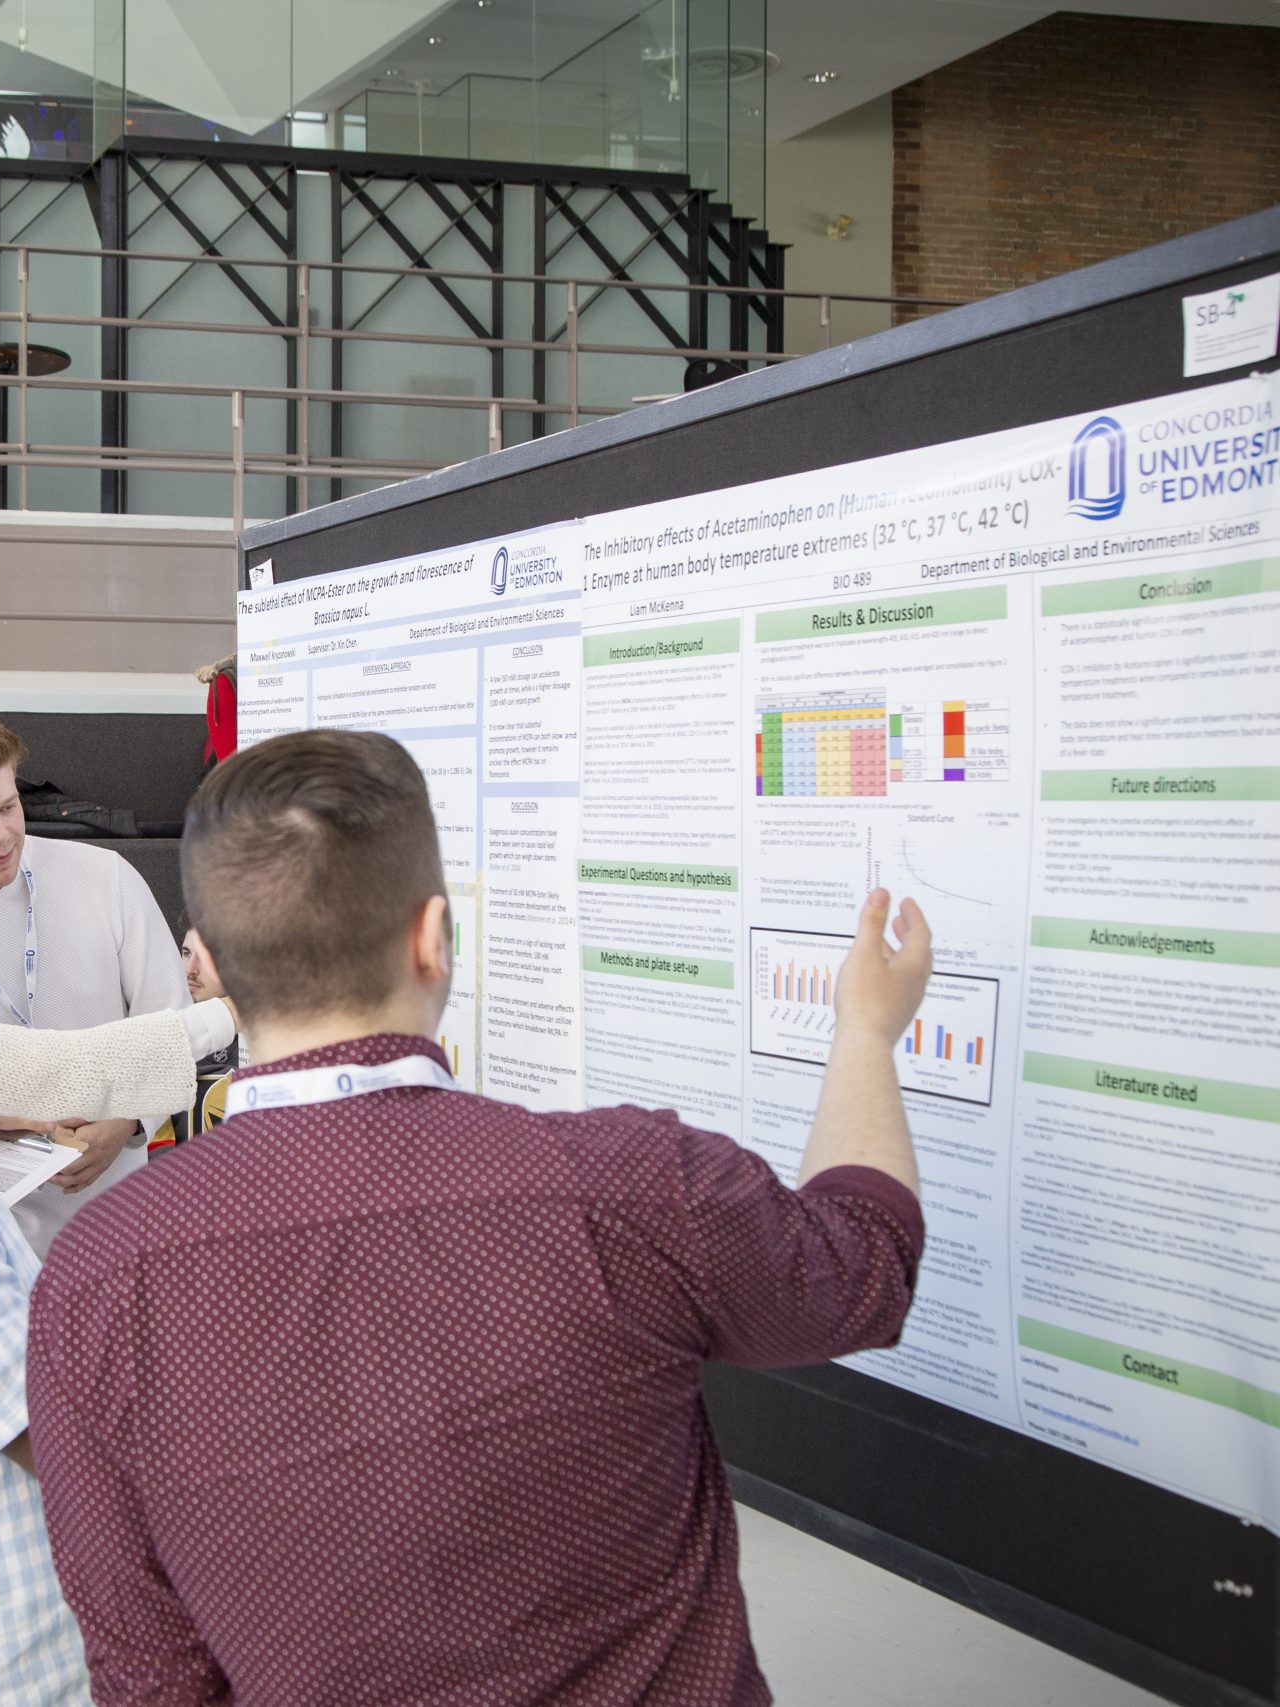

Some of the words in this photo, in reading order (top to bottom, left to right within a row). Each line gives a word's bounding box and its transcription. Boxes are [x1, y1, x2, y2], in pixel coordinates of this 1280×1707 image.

[1138, 401, 1273, 443] CONCORDIA
[1139, 482, 1159, 494] OF
[1161, 459, 1280, 503] EDMONT
[585, 544, 601, 561] The
[604, 535, 654, 557] Inhibitory
[657, 526, 694, 548] effects
[697, 520, 711, 541] of
[713, 504, 812, 537] Acetaminophen
[818, 501, 834, 519] on
[839, 493, 896, 520] (Human
[1018, 457, 1062, 484] COX-
[511, 546, 547, 560] CONCORDIA
[583, 576, 588, 591] 1
[592, 568, 629, 591] Enzyme
[633, 566, 643, 583] at
[646, 559, 684, 580] human
[688, 552, 716, 576] body
[720, 540, 799, 571] temperature
[803, 531, 868, 556] extremes
[873, 523, 895, 550] (32
[902, 519, 921, 543] °C,
[927, 515, 945, 538] 37
[952, 511, 973, 535] °C,
[979, 507, 998, 529] 42
[1005, 500, 1029, 529] °C)
[921, 558, 990, 580] Department
[993, 553, 1006, 569] of
[1009, 544, 1069, 567] Biological
[1074, 542, 1098, 559] and
[1104, 526, 1204, 556] Environmental
[1209, 520, 1260, 542] Sciences
[510, 557, 557, 576] UNIVERSITY
[238, 601, 253, 614] The
[254, 596, 279, 613] sublethal
[281, 592, 296, 608] effect
[298, 589, 305, 603] of
[306, 583, 345, 601] MCPA-Ester
[347, 584, 356, 595] on
[358, 580, 369, 591] the
[371, 572, 397, 593] growth
[400, 571, 414, 583] and
[416, 562, 461, 581] florescence
[464, 554, 475, 572] of
[515, 570, 563, 589] EDMONTON
[834, 574, 850, 590] BIO
[853, 572, 871, 587] 489
[1139, 578, 1212, 600] Conclusion
[314, 612, 340, 625] Brassica
[342, 605, 363, 623] napus
[365, 603, 370, 616] L.
[630, 601, 647, 617] Liam
[649, 600, 684, 614] McKenna
[812, 612, 852, 630] Results
[856, 609, 866, 625] &
[869, 603, 934, 625] Discussion
[409, 626, 441, 640] Department
[442, 624, 448, 634] of
[449, 619, 476, 635] Biological
[477, 618, 489, 629] and
[490, 611, 534, 627] Environmental
[535, 608, 564, 620] Sciences
[345, 639, 357, 648] Chen
[512, 644, 543, 656] CONCLUSION
[609, 637, 703, 660] Introduction/Background
[391, 661, 412, 671] APPROACH
[258, 676, 283, 686] BACKGROUND
[1111, 778, 1150, 794] Future
[1153, 776, 1216, 793] directions
[511, 802, 538, 811] DISCUSSION
[581, 865, 627, 879] Experimental
[630, 867, 668, 882] Questions
[670, 870, 685, 883] and
[687, 870, 731, 886] hypothesis
[1089, 928, 1216, 955] Acknowledgements
[600, 952, 633, 966] Methods
[635, 956, 649, 968] and
[651, 957, 671, 972] plate
[673, 961, 699, 976] set-up
[1095, 1070, 1160, 1097] Literature
[1163, 1083, 1198, 1102] cited
[1123, 1353, 1180, 1385] Contact
